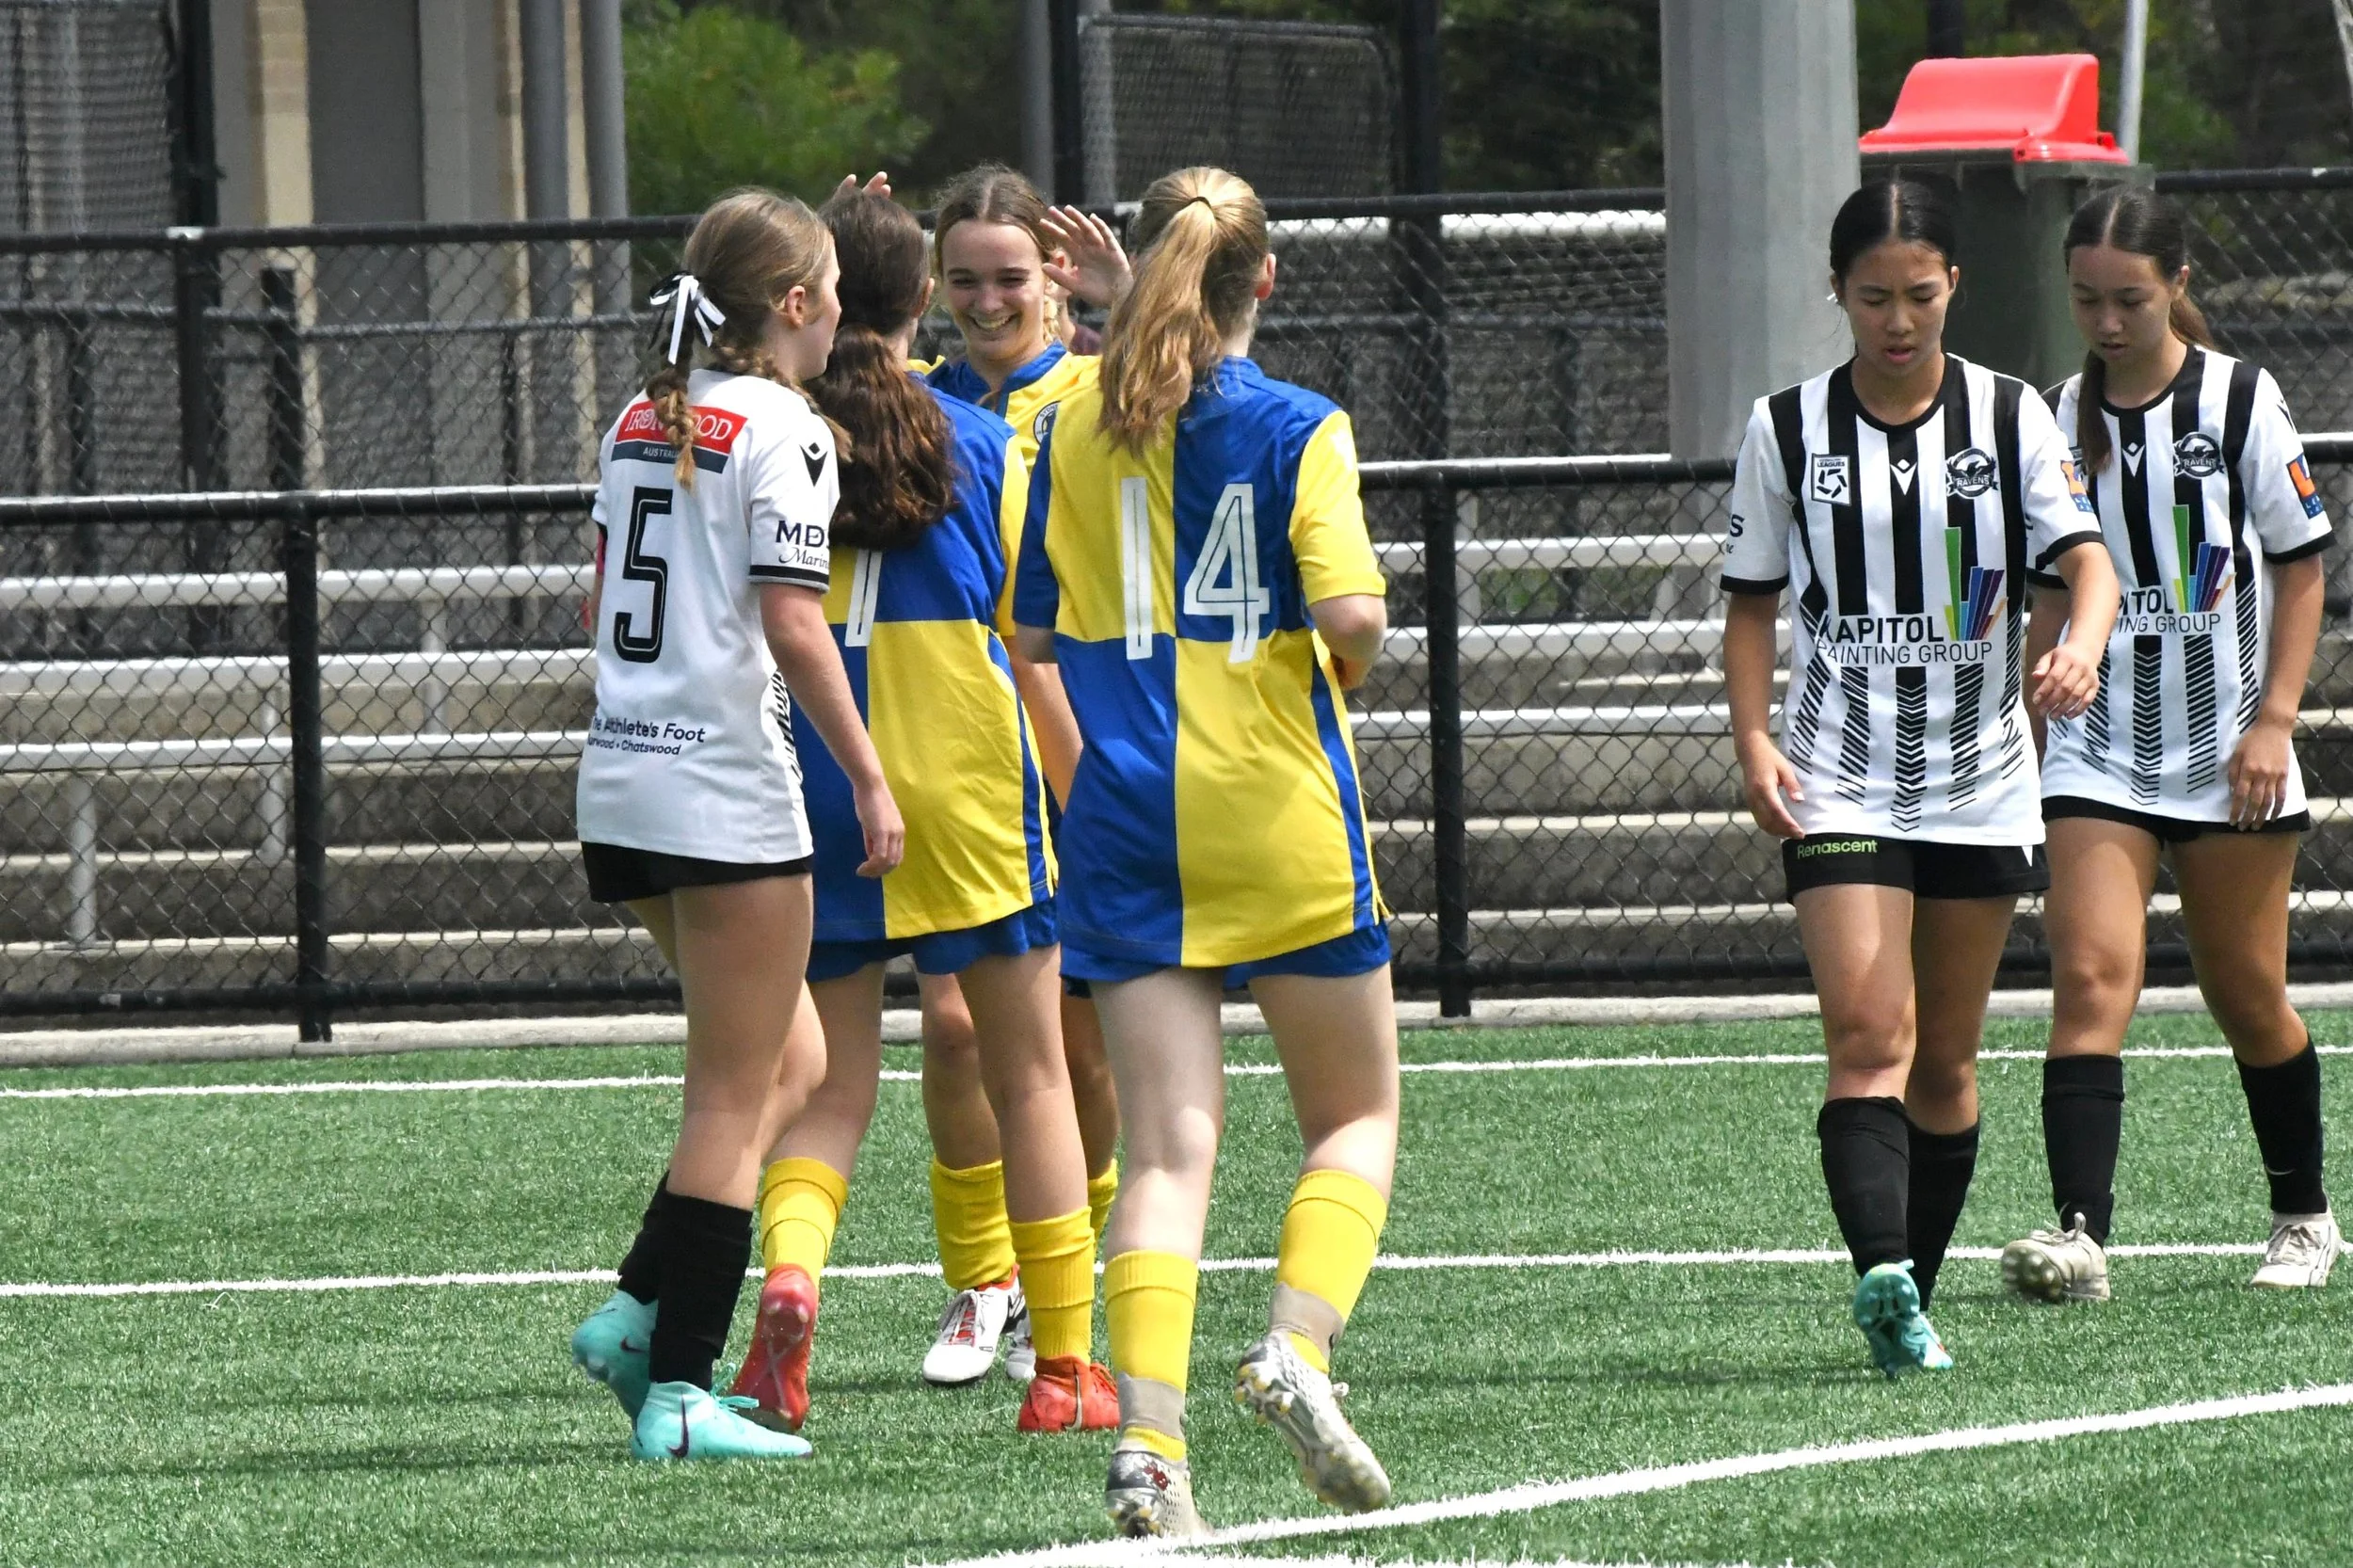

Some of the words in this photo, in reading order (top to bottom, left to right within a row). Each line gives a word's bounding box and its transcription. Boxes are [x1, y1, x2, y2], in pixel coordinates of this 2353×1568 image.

[1957, 476, 1990, 487] RAVENS
[776, 520, 829, 548] MD
[614, 486, 674, 664] 5
[1121, 476, 1270, 664] 14
[2155, 614, 2221, 633] GROUP
[1918, 641, 1993, 664] GROUP
[603, 717, 659, 738] Athlete's
[663, 723, 705, 743] Foot
[621, 739, 681, 755] Chatswood
[1797, 840, 1879, 859] Renascent
